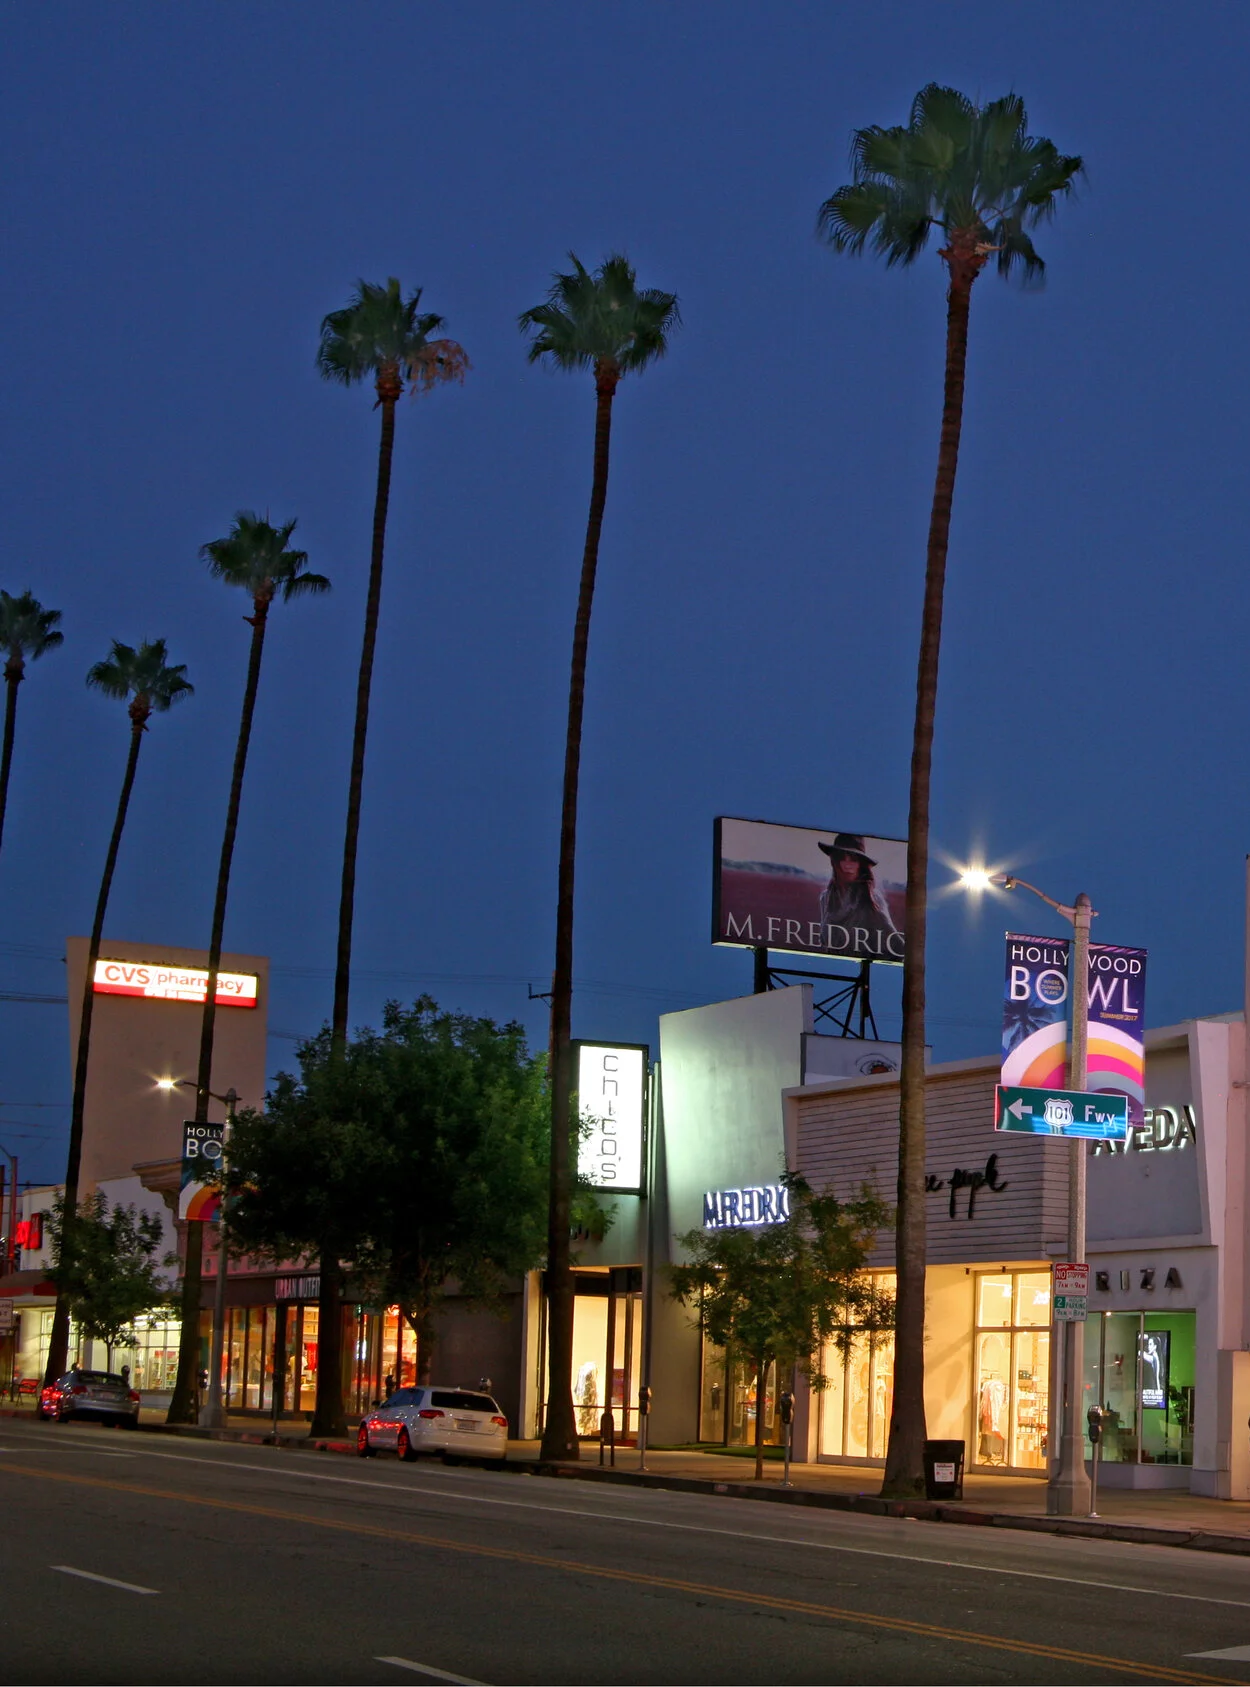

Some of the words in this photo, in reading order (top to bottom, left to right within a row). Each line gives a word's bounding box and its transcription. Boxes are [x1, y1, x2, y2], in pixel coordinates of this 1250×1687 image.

[1048, 1106, 1069, 1119] 101
[1084, 1105, 1116, 1126] Fwy
[1057, 1298, 1062, 1307] 2
